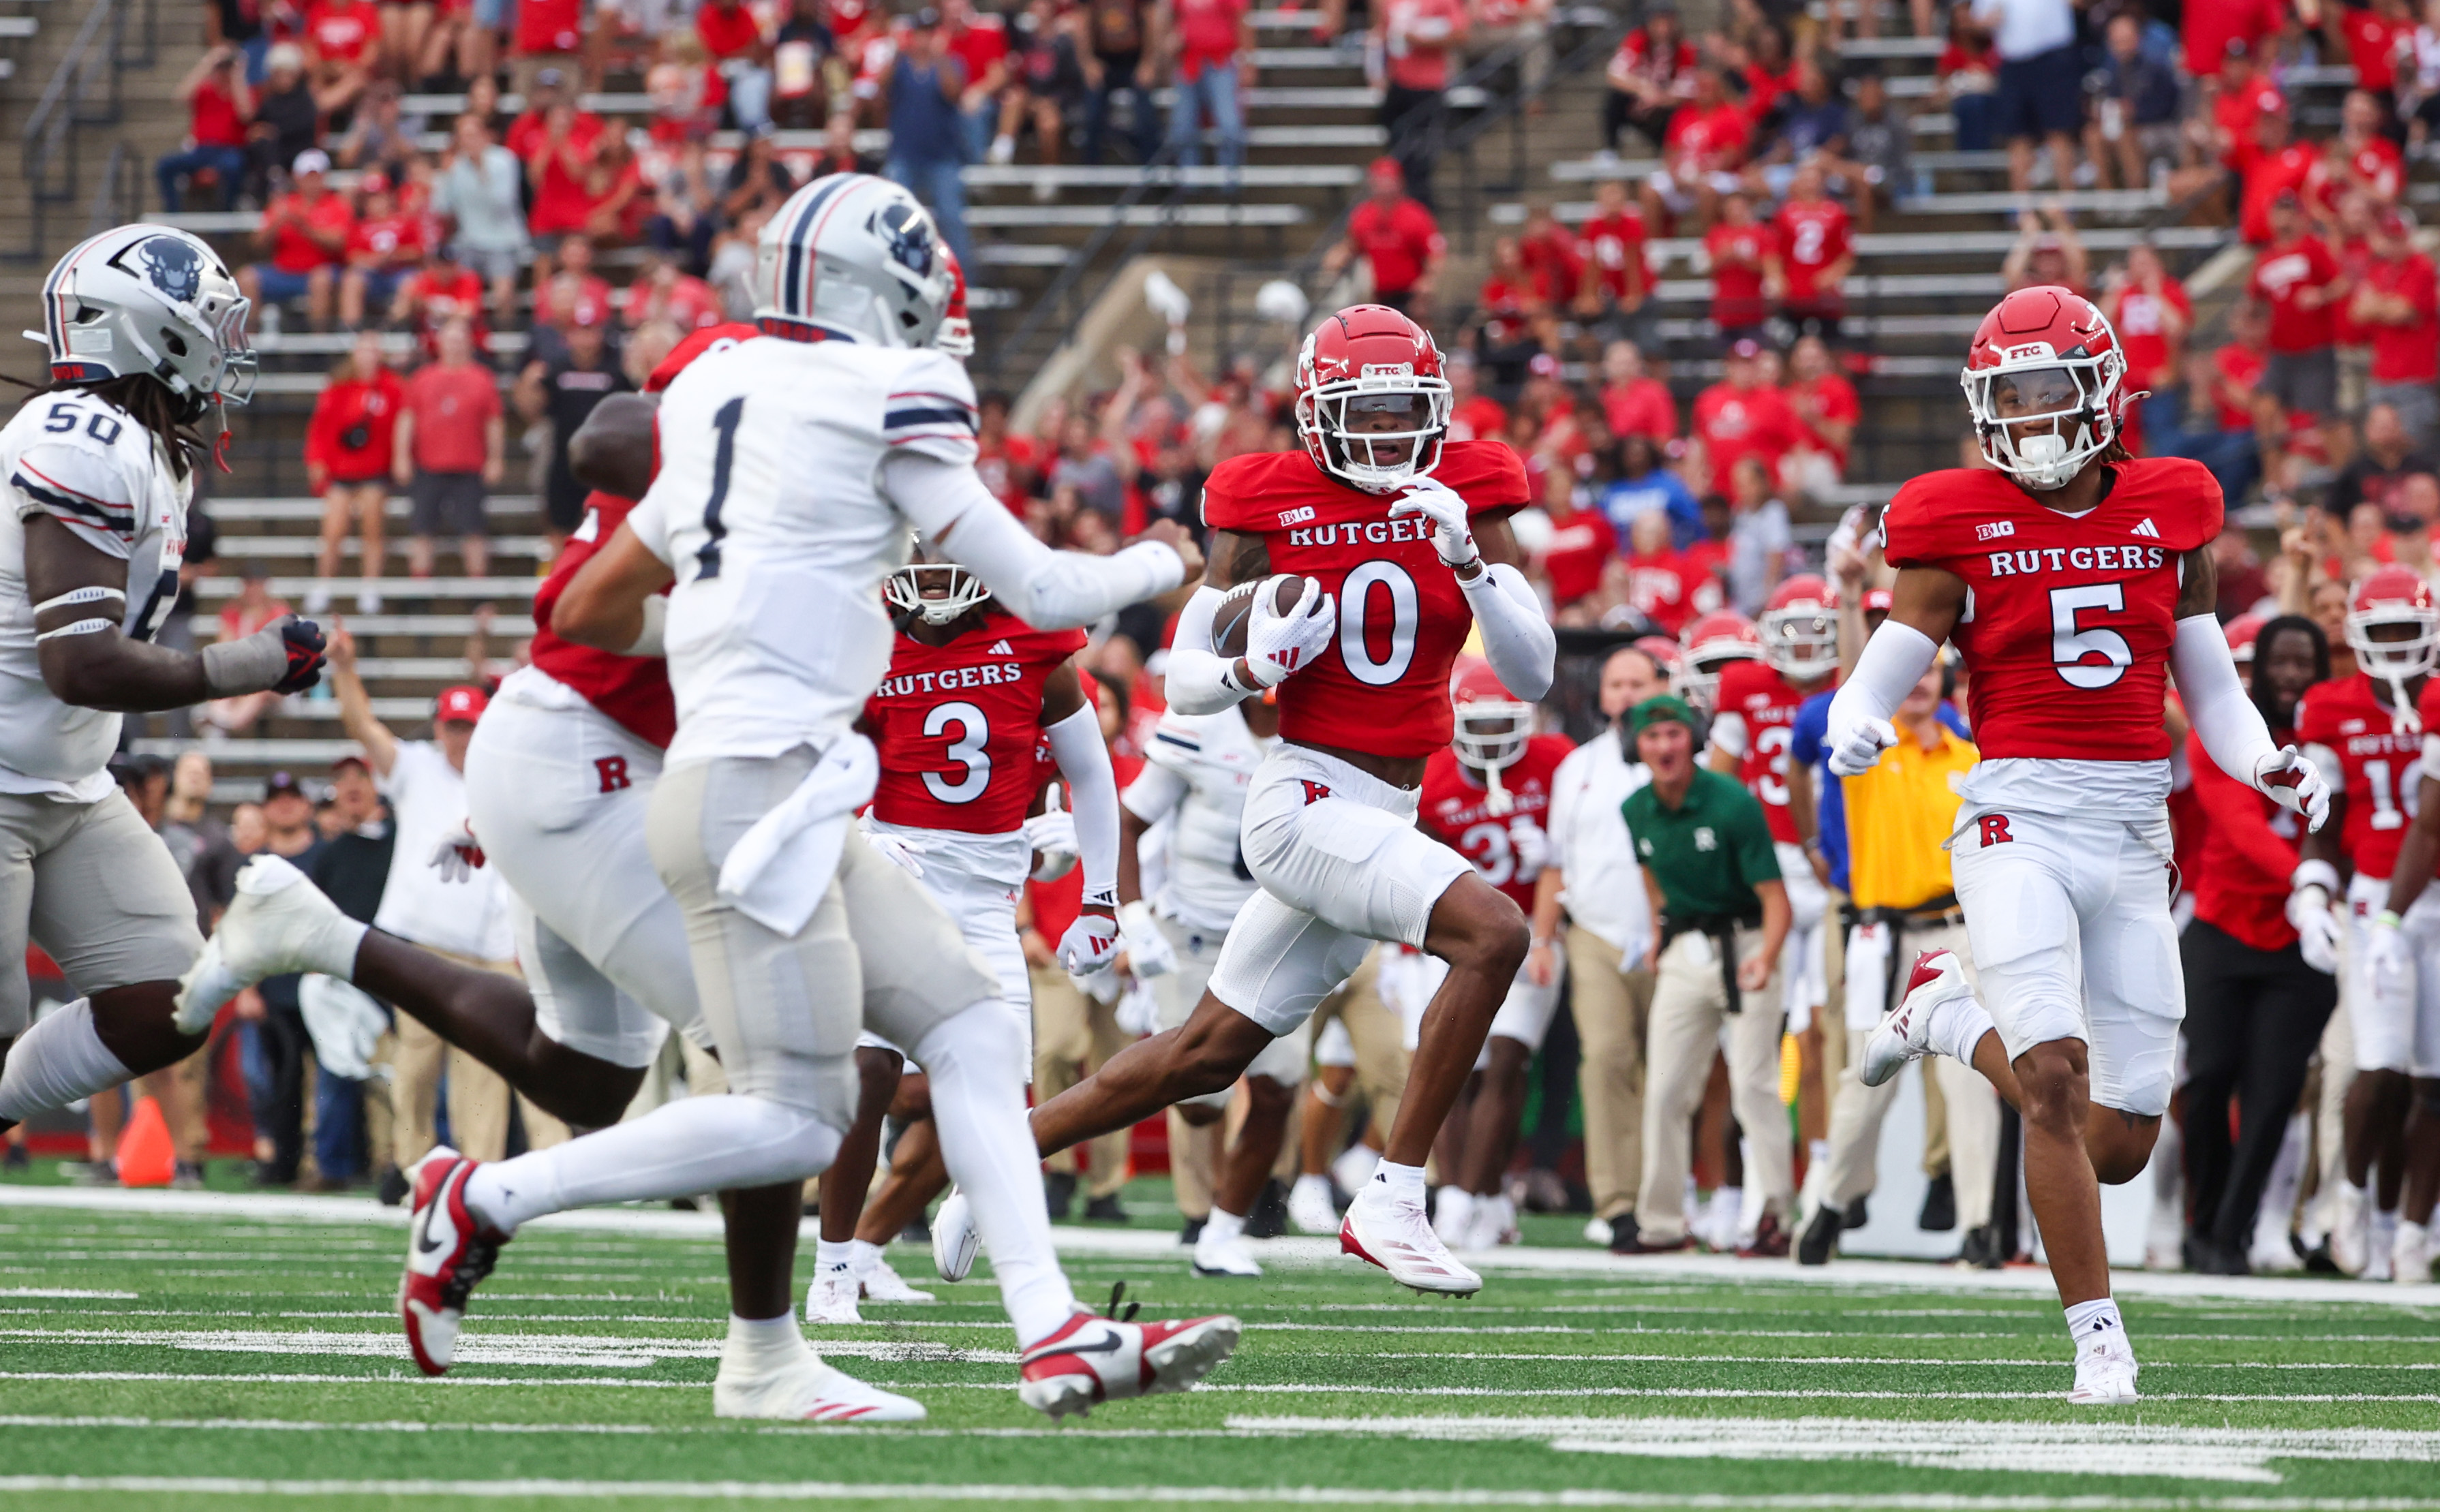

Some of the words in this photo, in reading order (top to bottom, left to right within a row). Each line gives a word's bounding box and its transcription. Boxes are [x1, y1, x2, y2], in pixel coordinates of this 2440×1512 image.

[45, 403, 123, 446] 50
[692, 395, 746, 583] 1
[1988, 545, 2165, 577] RUTGERS
[1340, 558, 1420, 687] 0
[2047, 581, 2135, 690] 5
[876, 662, 1022, 698] RUTGERS
[921, 700, 993, 804] 3
[593, 755, 631, 793] R
[1978, 814, 2013, 848] R
